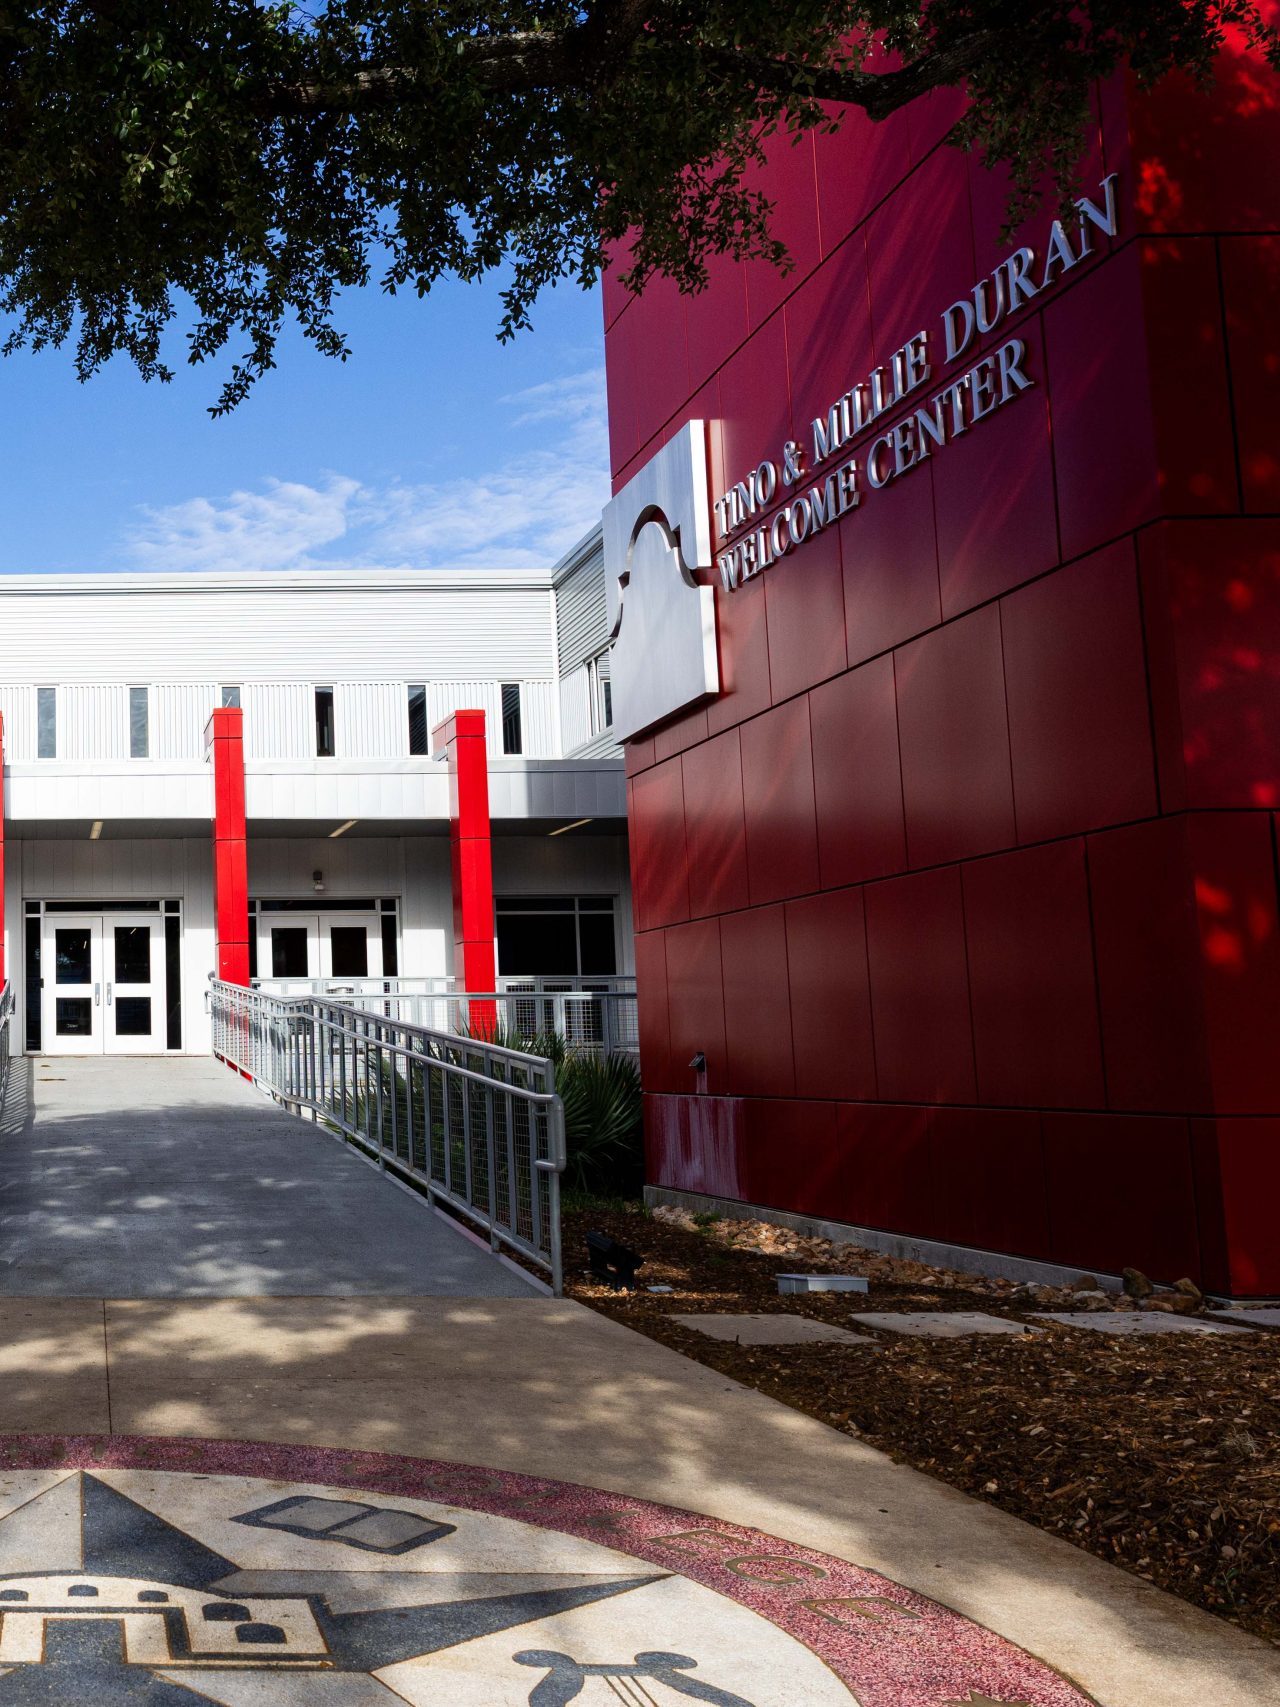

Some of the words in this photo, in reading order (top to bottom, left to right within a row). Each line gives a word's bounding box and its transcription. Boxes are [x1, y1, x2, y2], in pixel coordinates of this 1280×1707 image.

[715, 461, 776, 538] TINO
[783, 441, 804, 486] &
[810, 331, 931, 464] MILLIE
[941, 173, 1119, 364] DURAN
[717, 459, 859, 592] WELCOME
[867, 339, 1034, 488] CENTER
